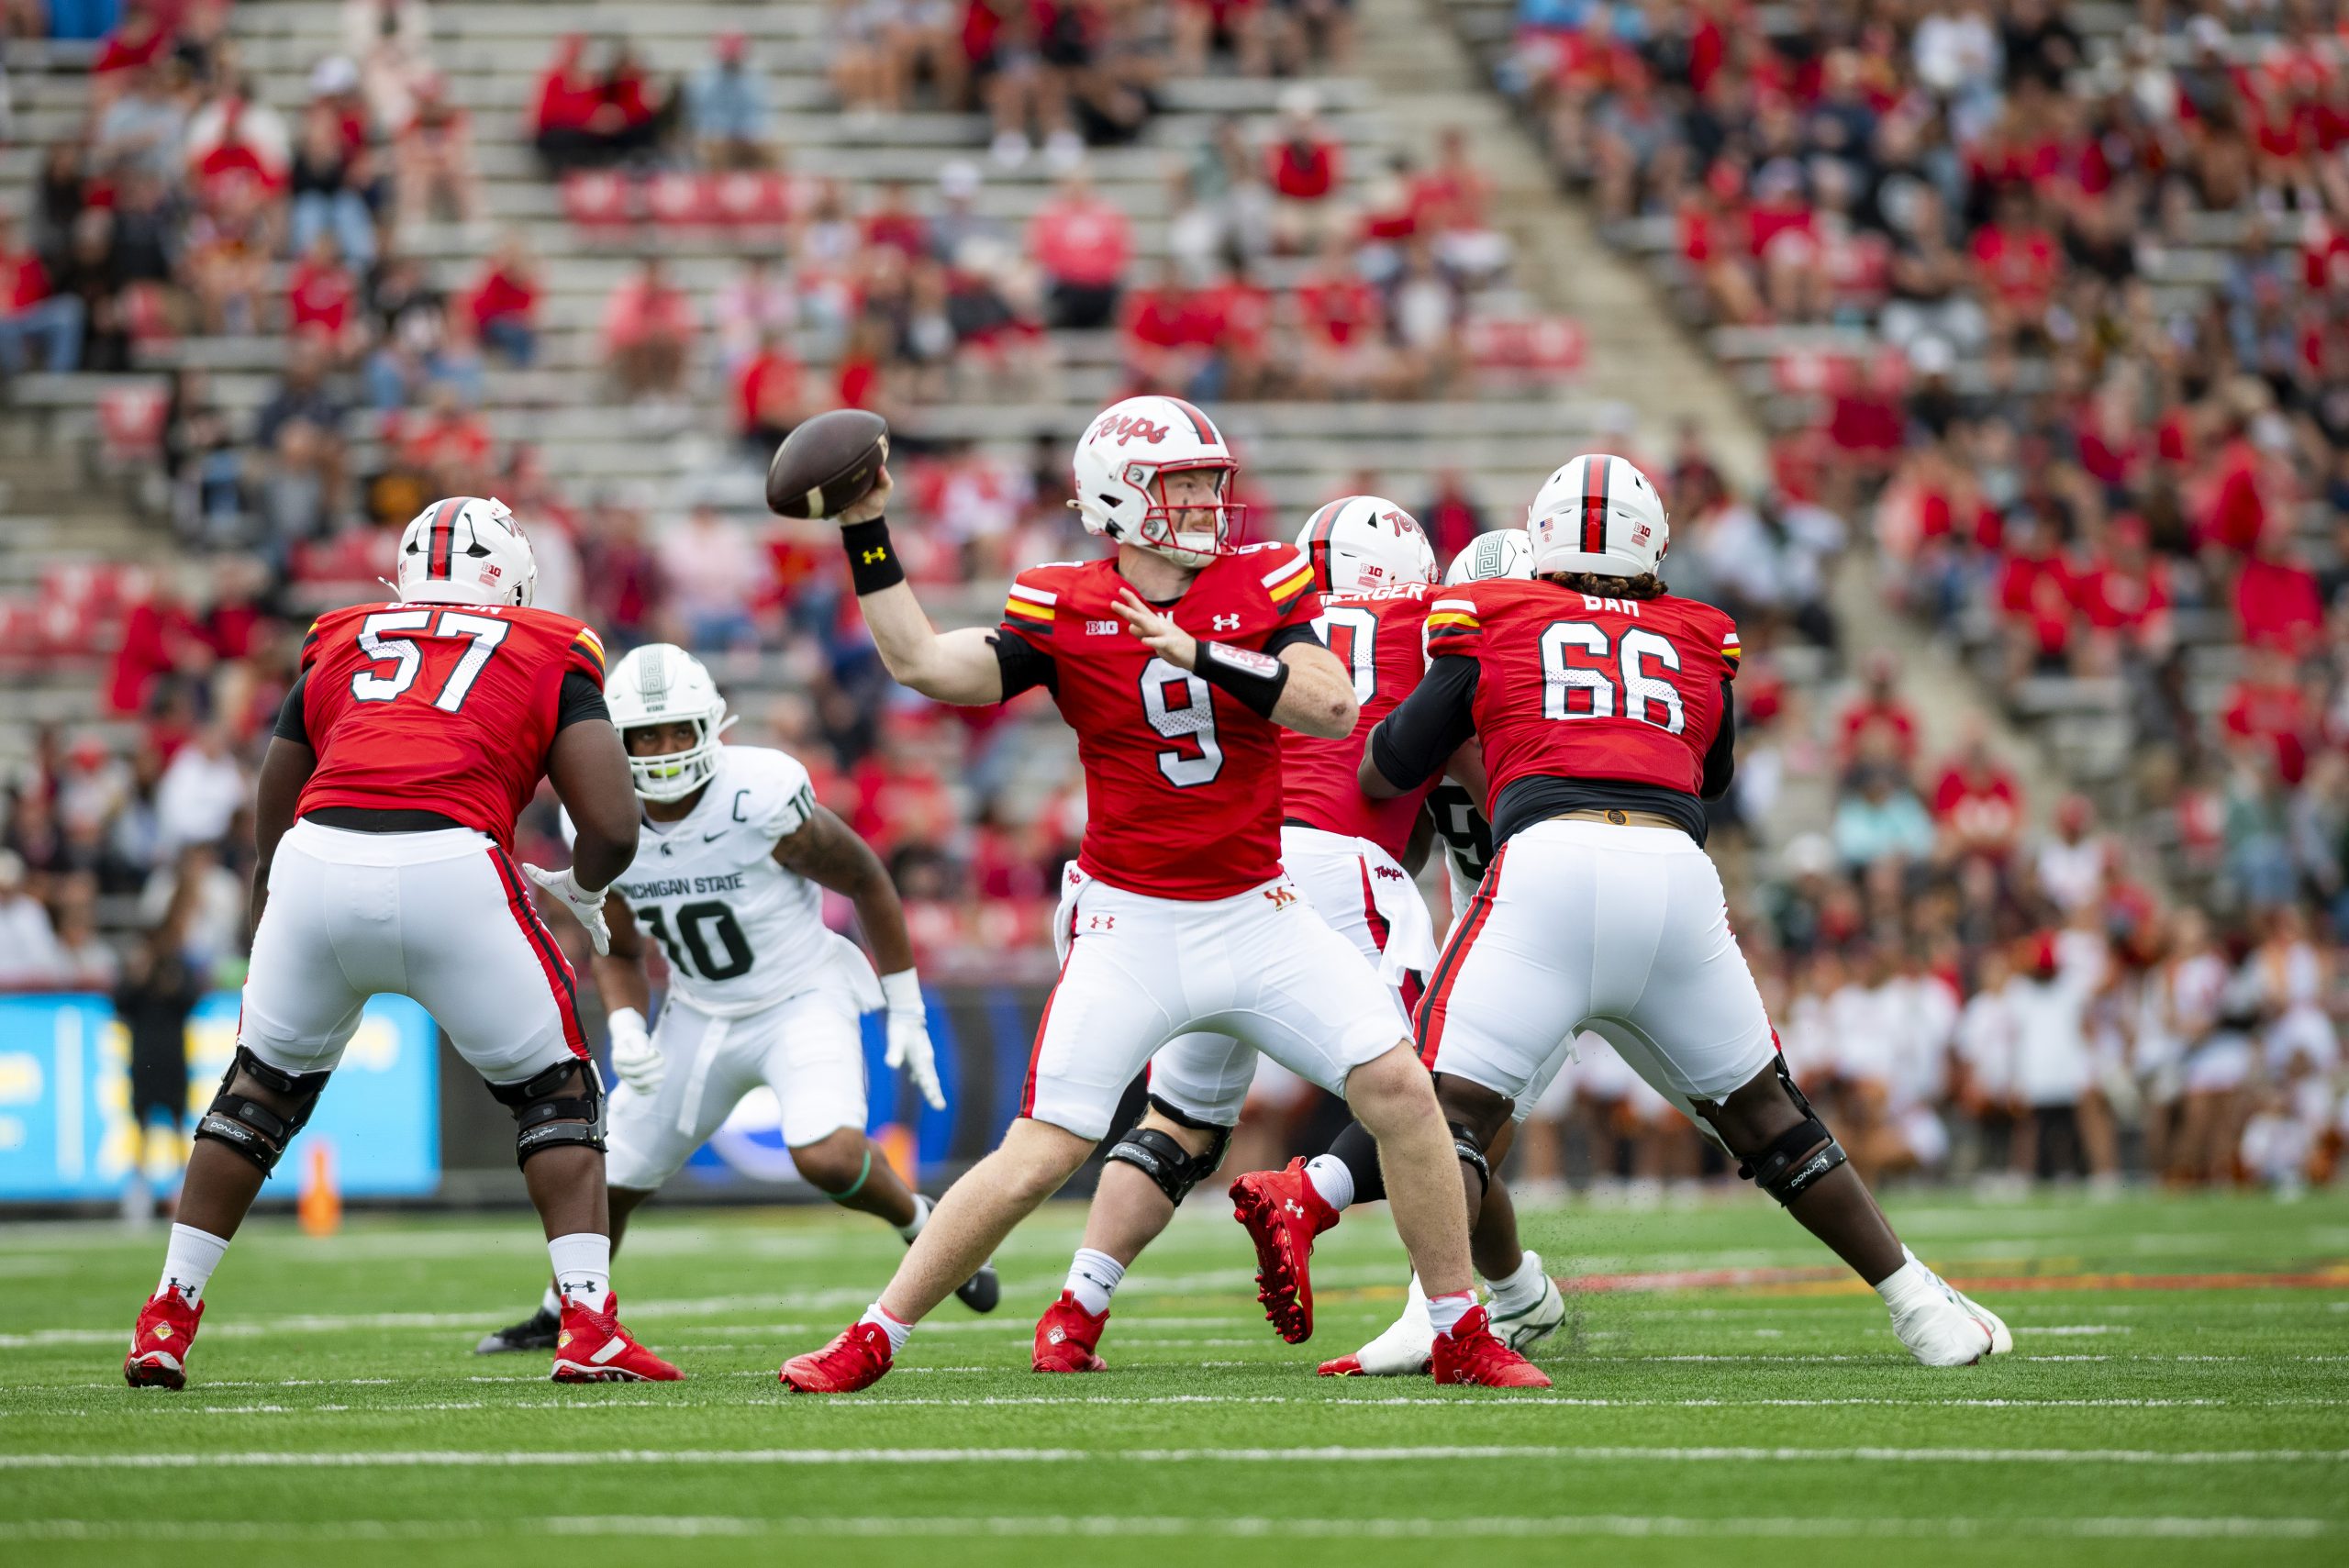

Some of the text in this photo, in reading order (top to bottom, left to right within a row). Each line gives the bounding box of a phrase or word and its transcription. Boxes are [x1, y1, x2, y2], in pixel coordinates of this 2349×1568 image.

[350, 609, 512, 715] 57
[1538, 620, 1687, 735] 66
[1139, 656, 1224, 789] 9
[733, 788, 751, 823] C
[695, 872, 749, 895] STATE
[637, 899, 754, 982] 10
[211, 1121, 250, 1140] DONJOY
